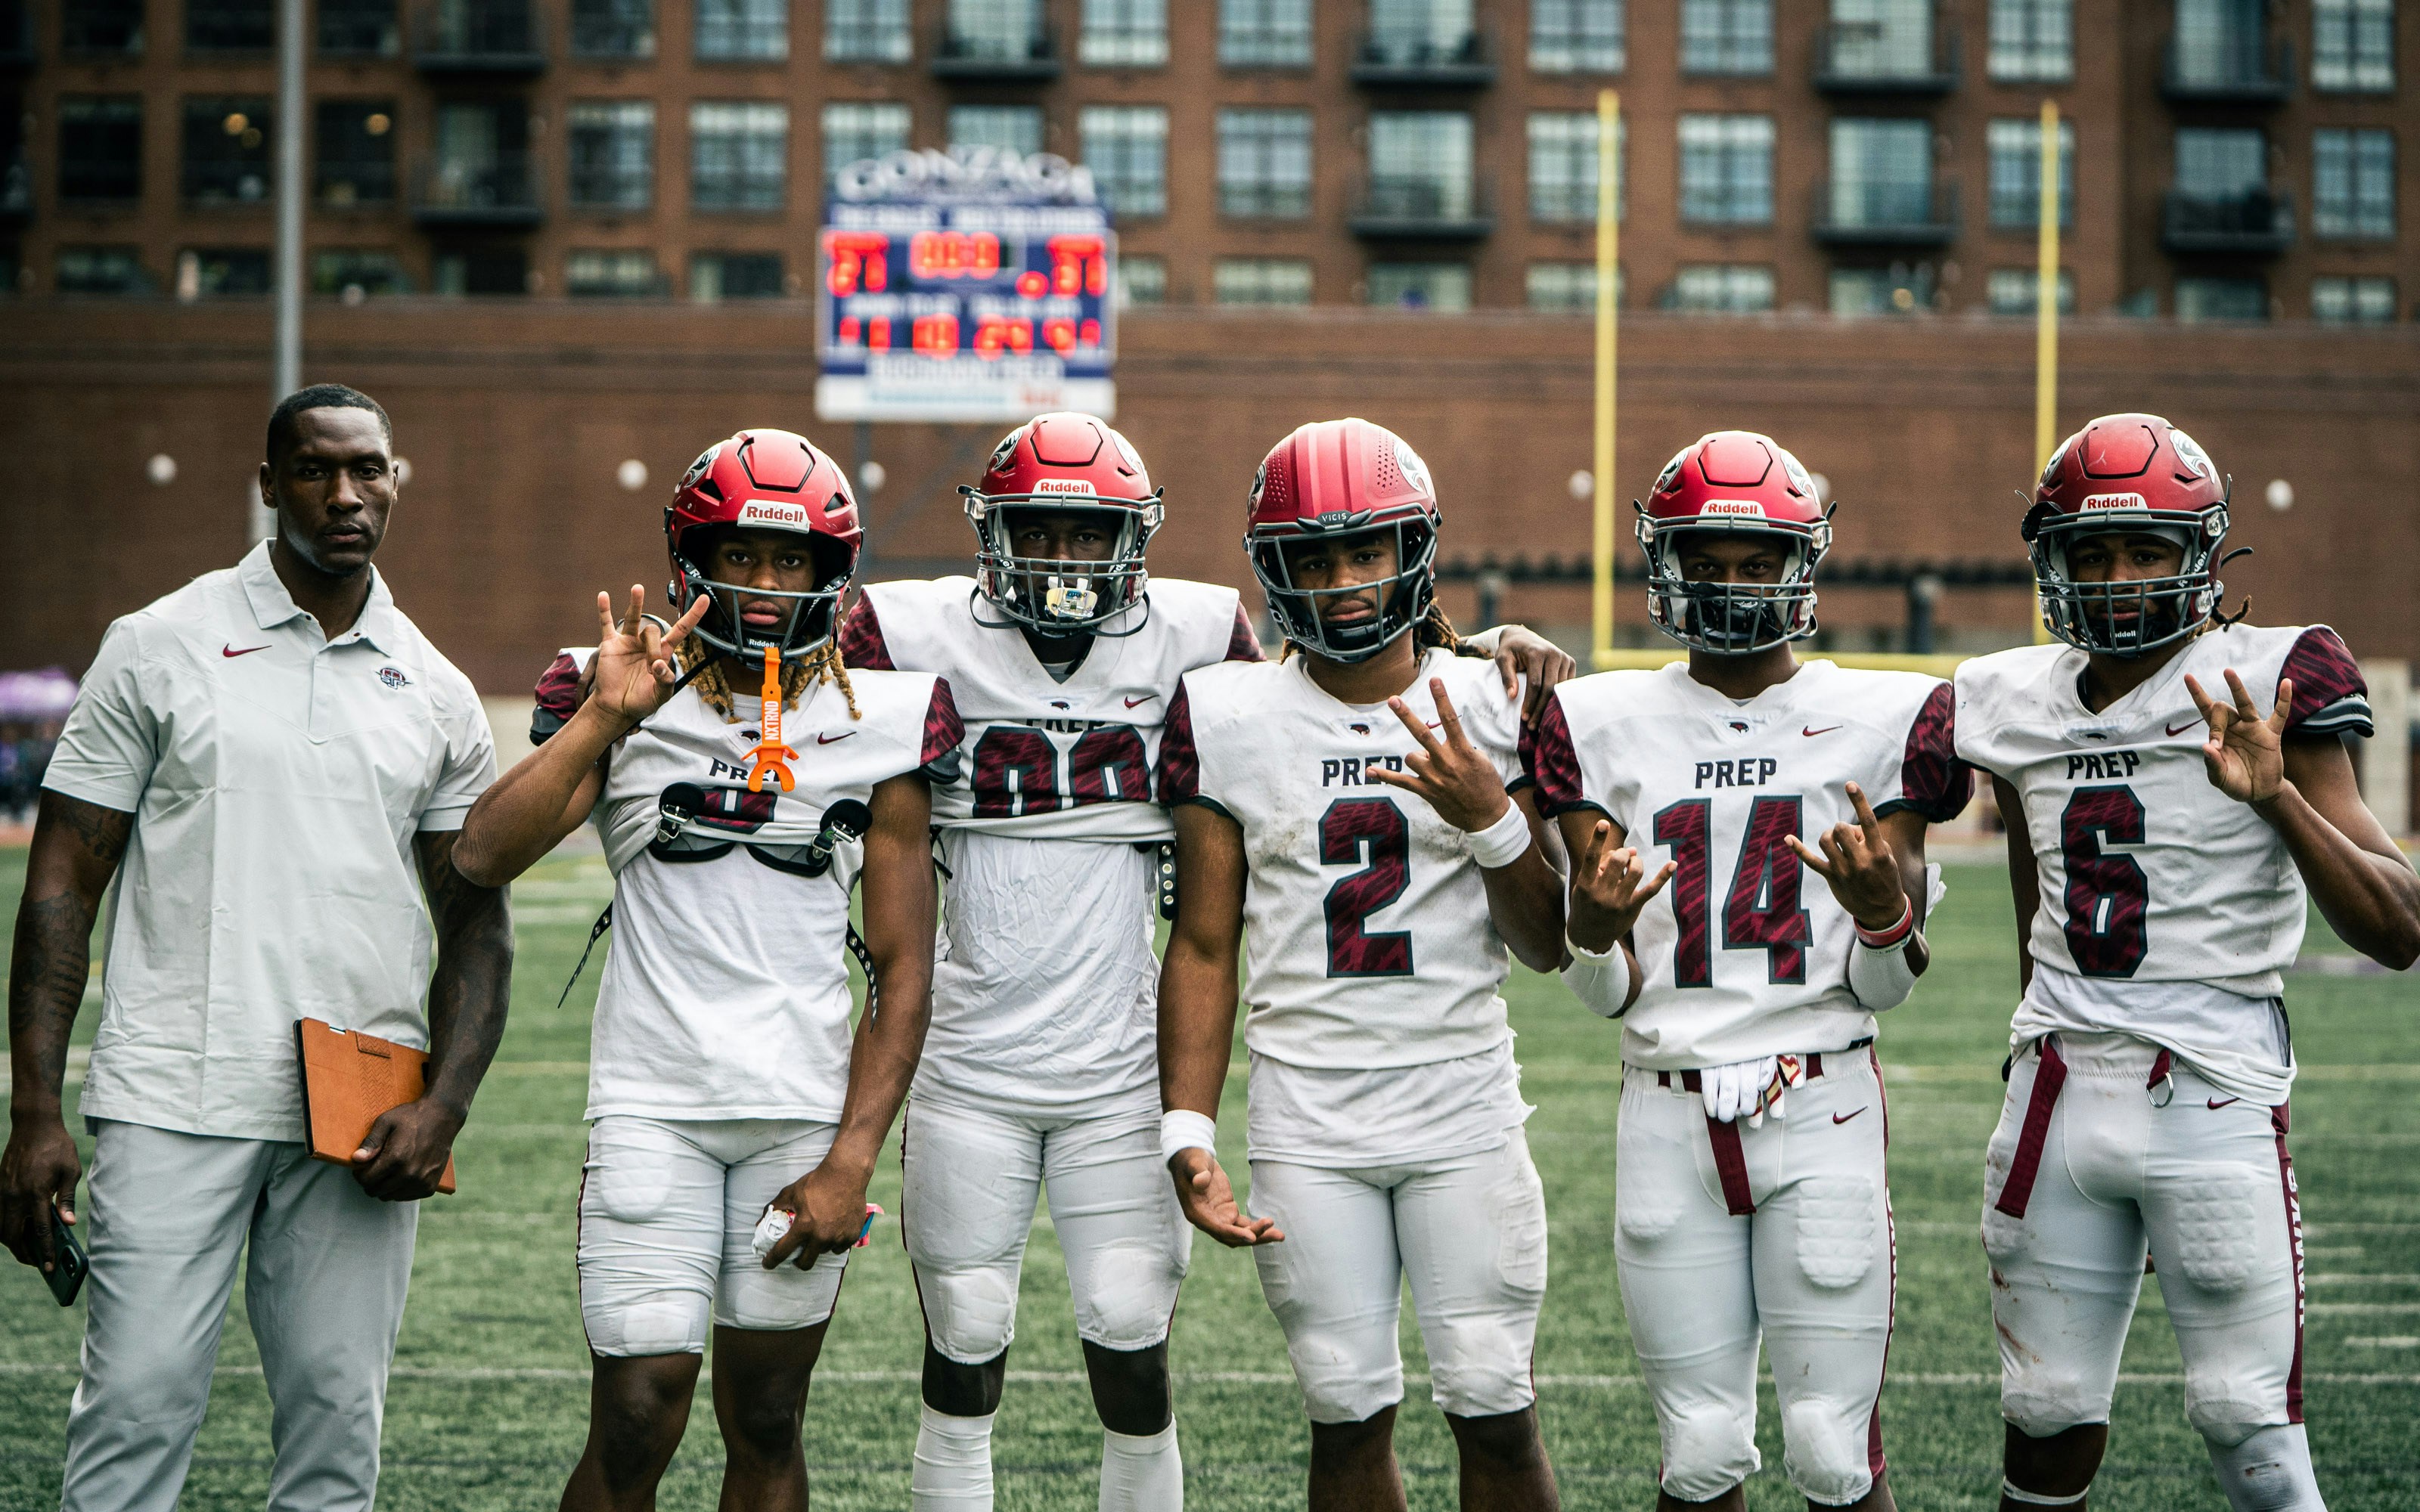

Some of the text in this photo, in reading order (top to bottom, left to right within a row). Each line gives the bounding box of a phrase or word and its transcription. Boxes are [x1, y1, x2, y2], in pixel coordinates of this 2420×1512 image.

[1041, 482, 1089, 493] Riddell
[1708, 503, 1758, 514] Riddell
[2087, 497, 2138, 509] Riddell
[746, 506, 803, 522] Riddell
[1322, 513, 1347, 522] VICIS
[749, 639, 774, 648] Riddell
[2111, 630, 2136, 638] iddell
[765, 700, 779, 741] NXTRND
[709, 757, 780, 782] PR
[1695, 758, 1777, 789] PREP
[2065, 750, 2140, 779] PREP
[1318, 796, 1414, 978] 2
[2061, 784, 2149, 978] 6
[1652, 795, 1813, 988] 14
